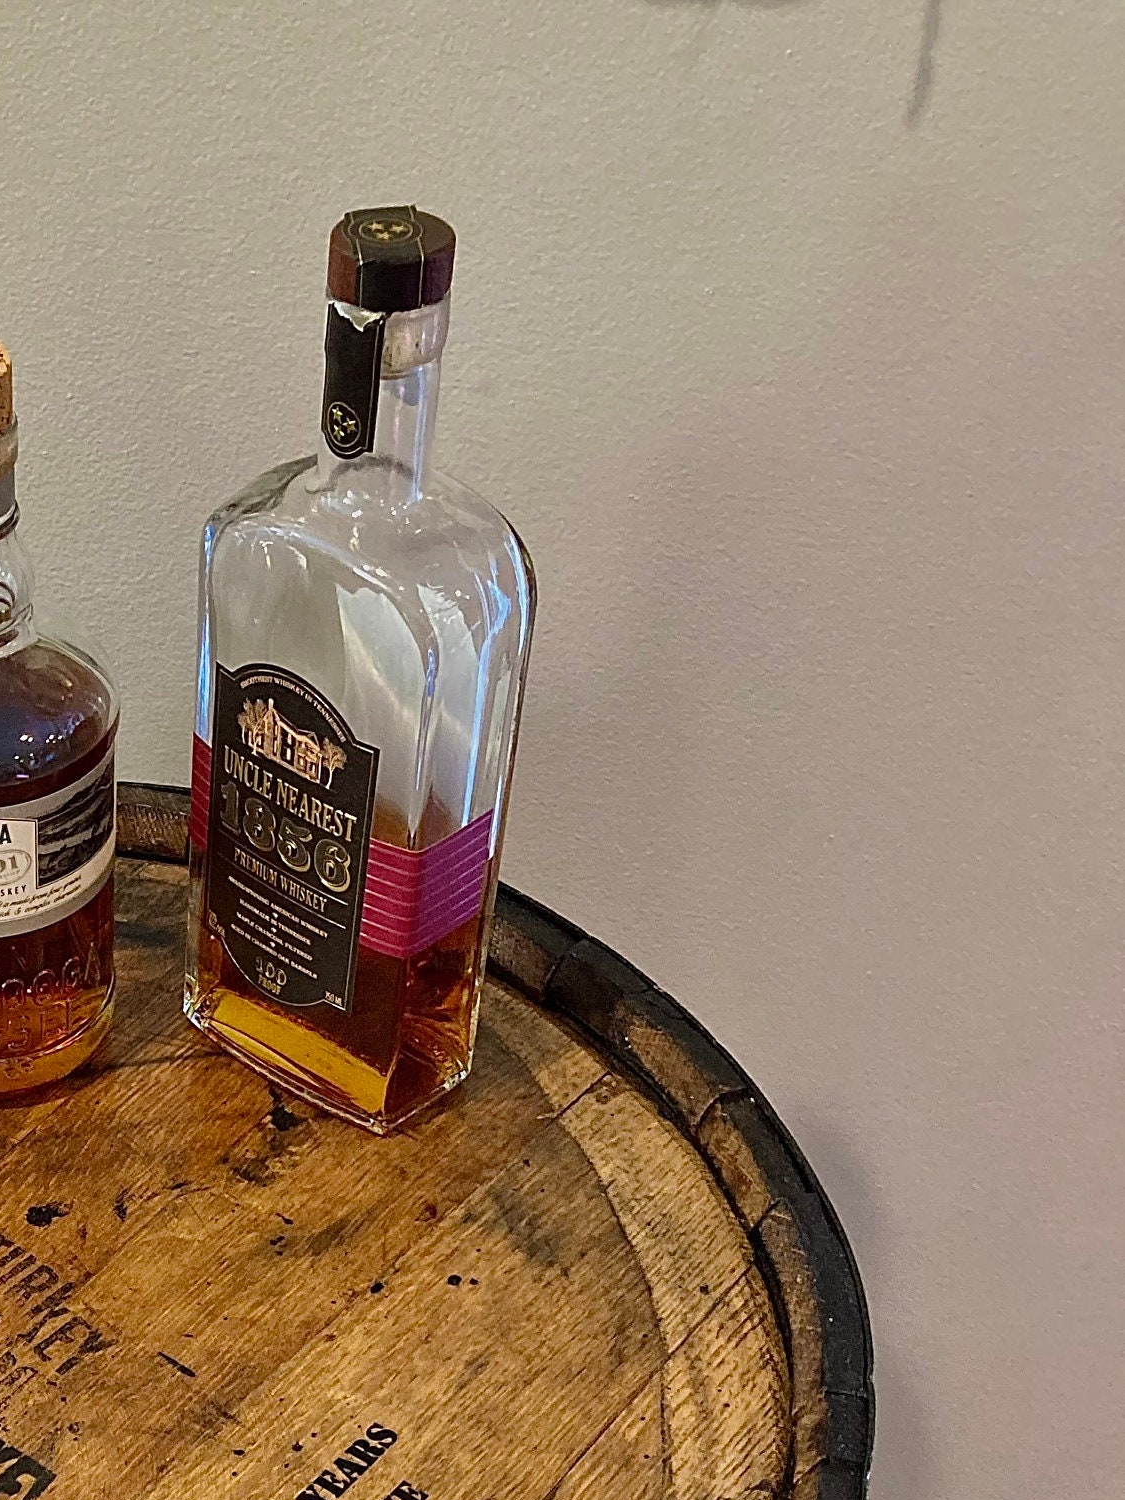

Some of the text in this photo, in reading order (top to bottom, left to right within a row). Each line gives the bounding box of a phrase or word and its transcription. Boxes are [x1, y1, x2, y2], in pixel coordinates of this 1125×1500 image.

[274, 677, 305, 696] WHISKEY
[305, 693, 313, 703] IN
[224, 744, 357, 842] UNCLE NEAREST
[220, 780, 351, 893] 1856
[234, 848, 327, 912] PREMIUM WHISKEY
[255, 956, 287, 986] 100
[258, 974, 281, 995] PROOF
